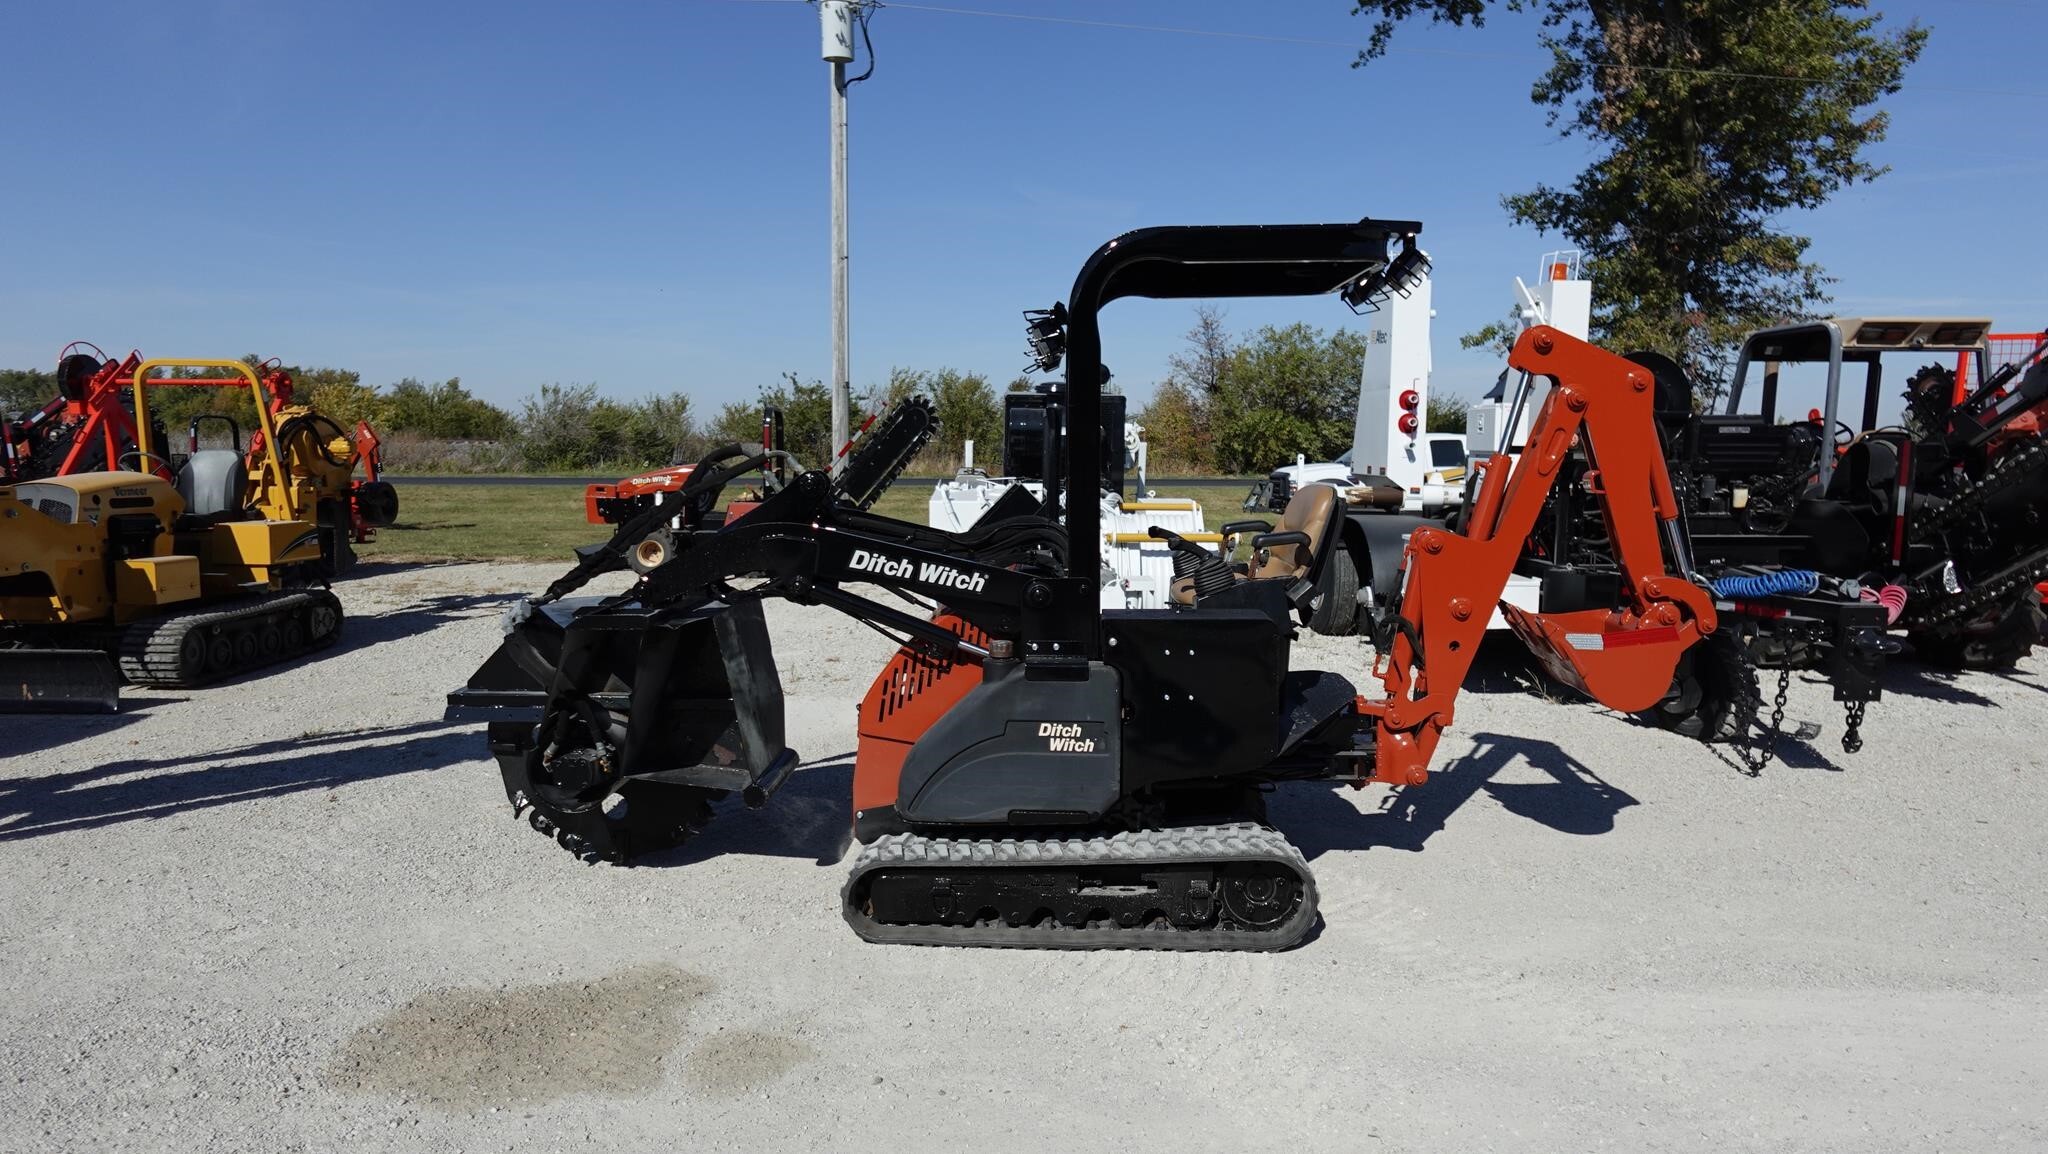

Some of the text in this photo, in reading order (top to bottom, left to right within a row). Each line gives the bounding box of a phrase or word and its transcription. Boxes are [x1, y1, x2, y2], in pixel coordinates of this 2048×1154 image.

[632, 475, 672, 485] Ditch Witch
[848, 549, 987, 593] Ditch Witch
[1038, 722, 1082, 738] Ditch
[1049, 738, 1095, 753] Witch
